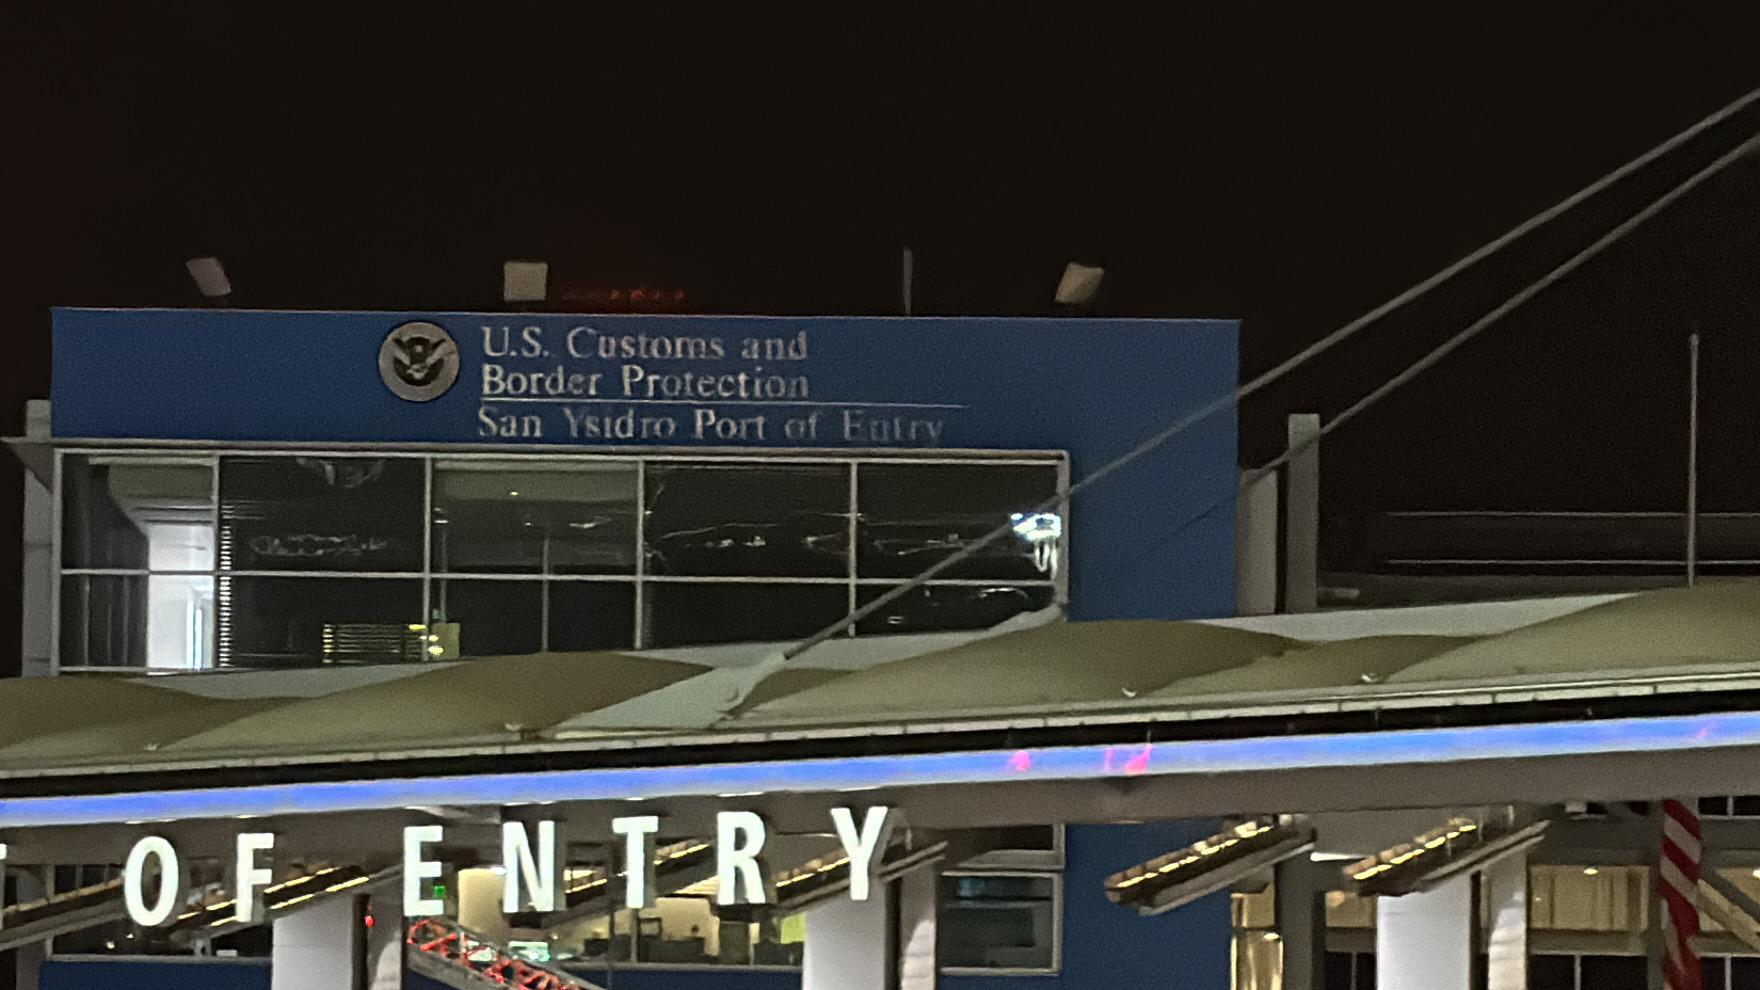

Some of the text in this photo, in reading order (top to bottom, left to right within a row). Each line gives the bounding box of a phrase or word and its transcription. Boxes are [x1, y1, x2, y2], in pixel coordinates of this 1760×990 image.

[481, 325, 808, 361] U.S. Customs and
[482, 363, 809, 399] Border Protection
[478, 405, 943, 446] San Ysidro Port of Entry
[123, 831, 275, 927] OF
[403, 805, 890, 917] ENTRY
